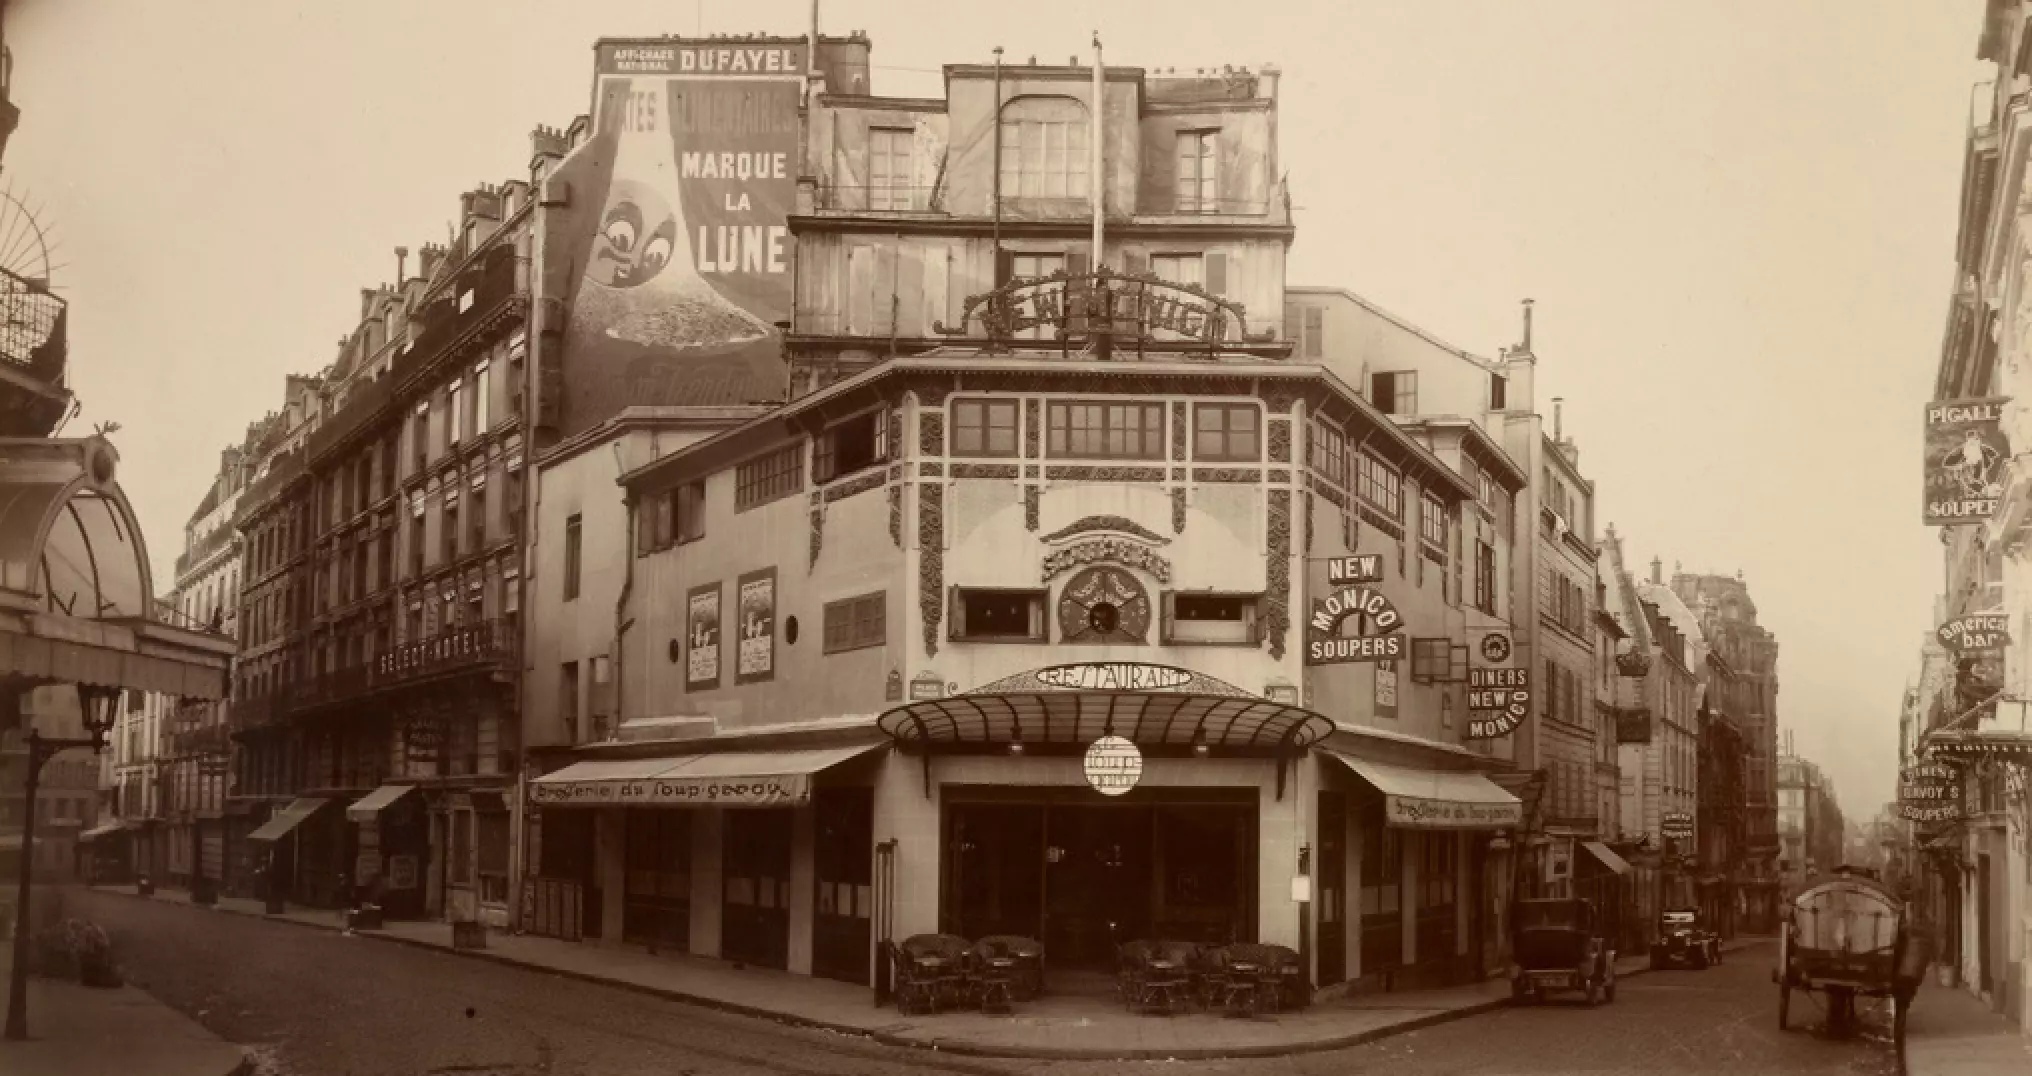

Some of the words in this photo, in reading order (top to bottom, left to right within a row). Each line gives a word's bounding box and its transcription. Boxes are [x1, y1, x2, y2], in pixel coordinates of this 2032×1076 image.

[680, 49, 797, 71] DUFAYEL
[682, 152, 786, 180] MARQUE
[725, 193, 751, 211] LA
[699, 225, 787, 273] LUNE
[1330, 556, 1377, 579] NEW
[1312, 588, 1397, 631] MONICO
[1311, 637, 1399, 659] SOUPERS
[1963, 629, 1997, 649] bar
[1045, 664, 1187, 688] RESTAURANT
[1469, 691, 1506, 707] NEW
[1471, 691, 1529, 737] MONICO
